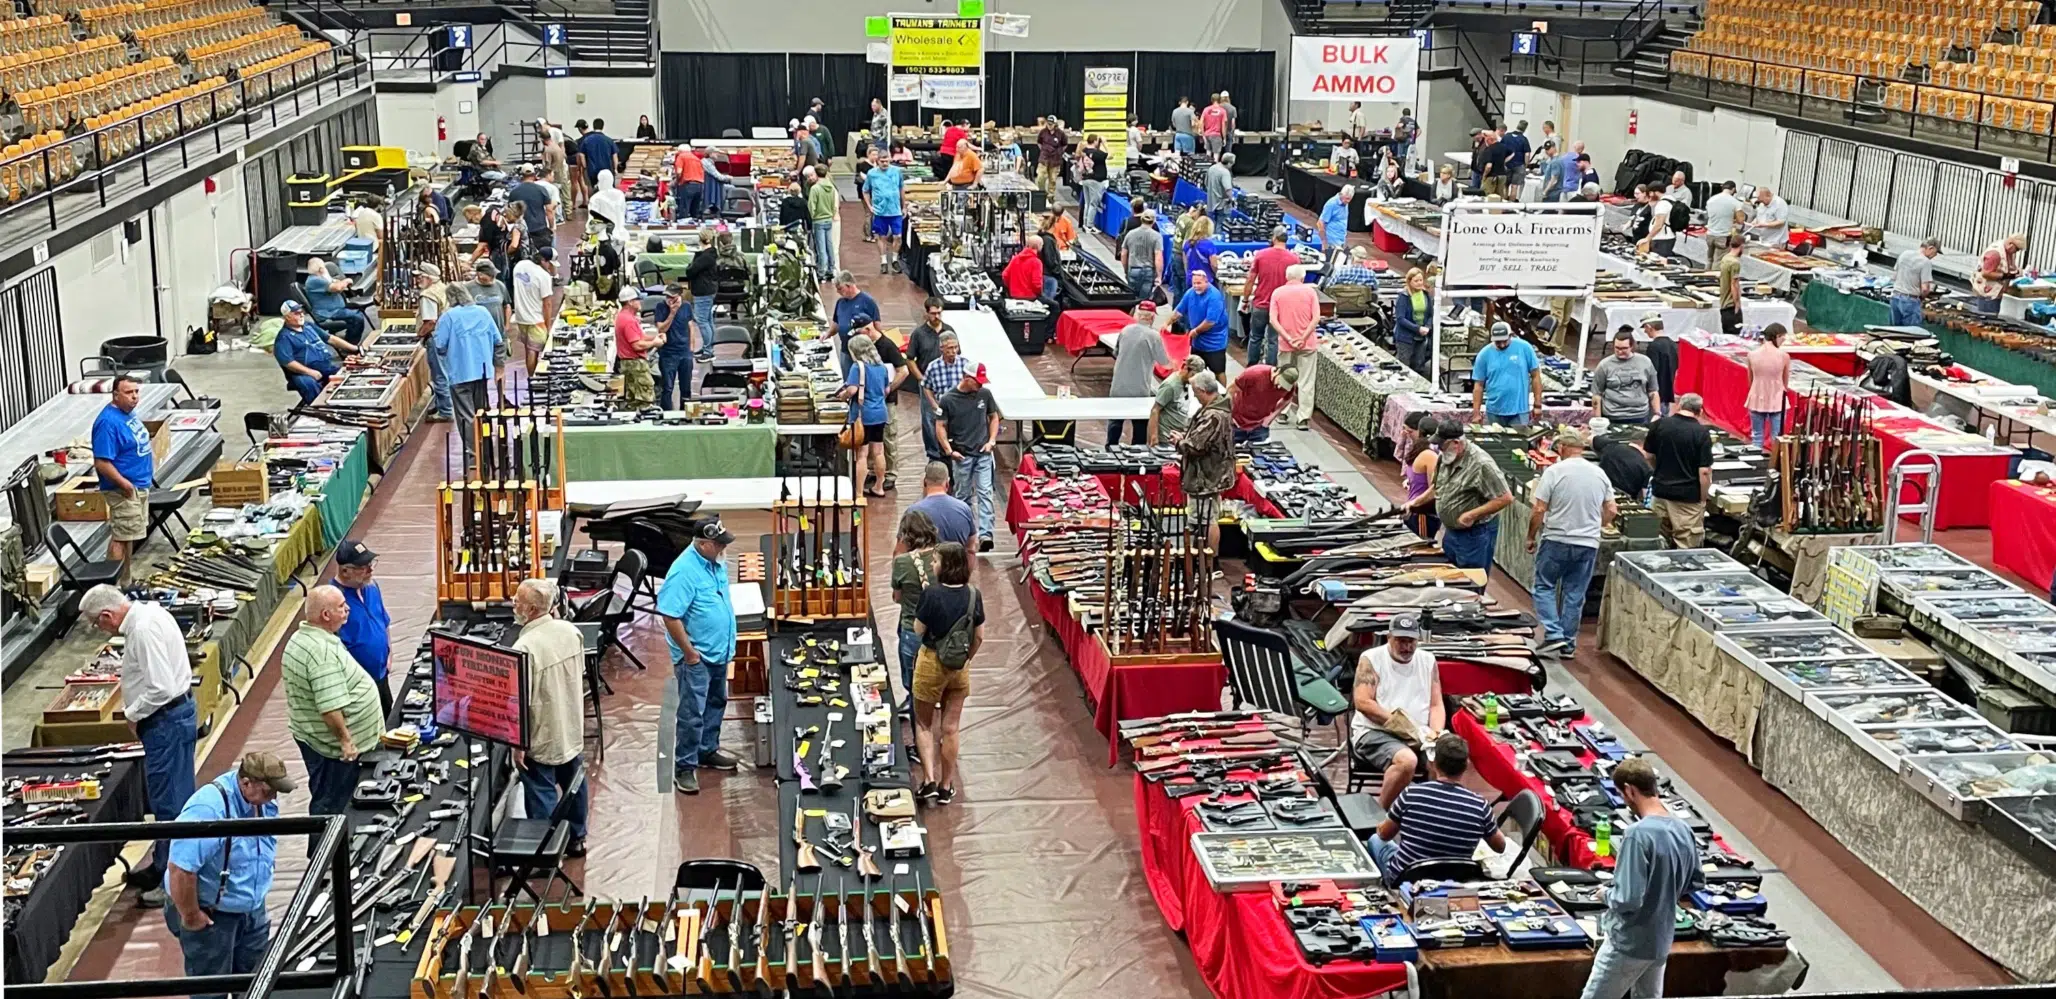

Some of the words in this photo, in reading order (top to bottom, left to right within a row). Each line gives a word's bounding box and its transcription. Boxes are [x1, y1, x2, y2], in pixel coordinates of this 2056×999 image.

[454, 30, 466, 47] 2
[549, 29, 560, 45] 2
[895, 34, 953, 45] Wholesale
[1518, 38, 1531, 54] 3
[1322, 45, 1389, 64] BULK
[1312, 74, 1396, 94] AMMO
[1453, 221, 1488, 235] Lone
[1494, 221, 1523, 235] Oak
[1530, 222, 1592, 235] Firearms
[1530, 264, 1557, 272] TRADE
